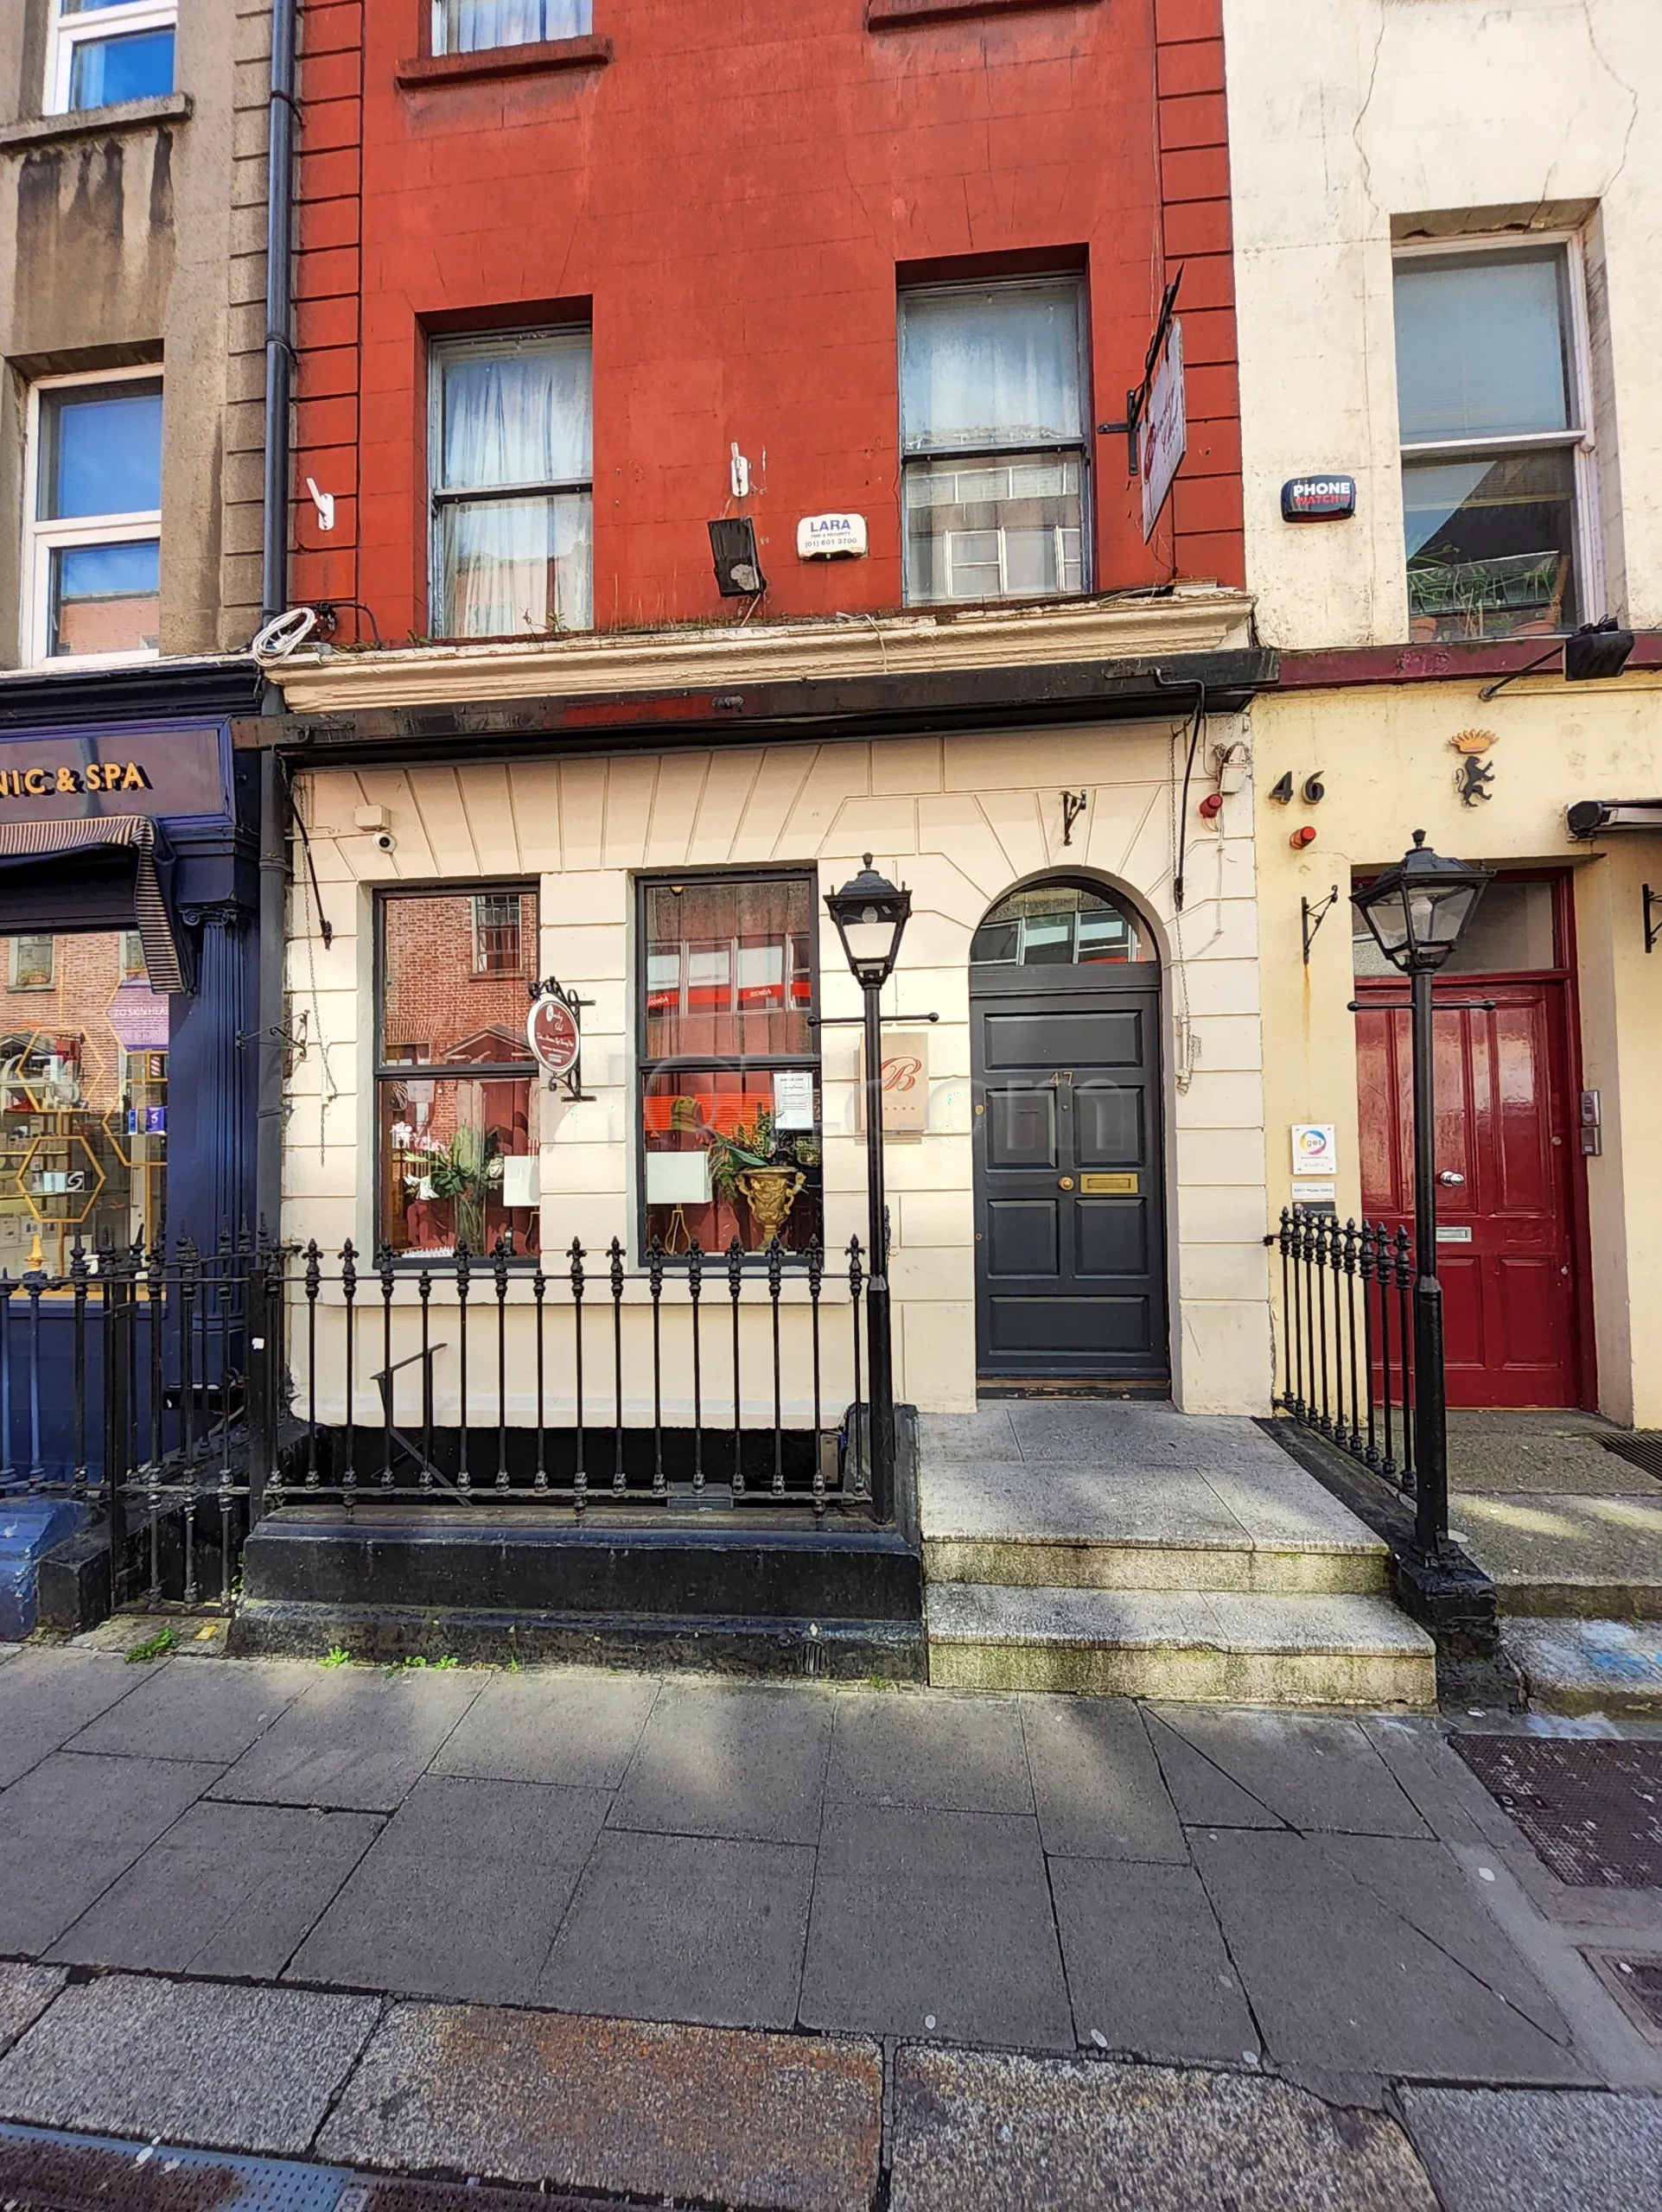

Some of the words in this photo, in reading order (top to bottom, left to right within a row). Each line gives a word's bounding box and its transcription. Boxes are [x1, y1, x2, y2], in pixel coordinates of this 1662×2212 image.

[1293, 482, 1351, 497] PHONE
[1295, 494, 1339, 505] WATCH
[810, 518, 851, 533] LARA
[805, 540, 819, 549] (01)
[56, 766, 77, 792] &
[86, 762, 146, 791] SPA
[1270, 770, 1326, 805] 46
[1048, 1071, 1073, 1087] 47
[1306, 1139, 1322, 1147] get
